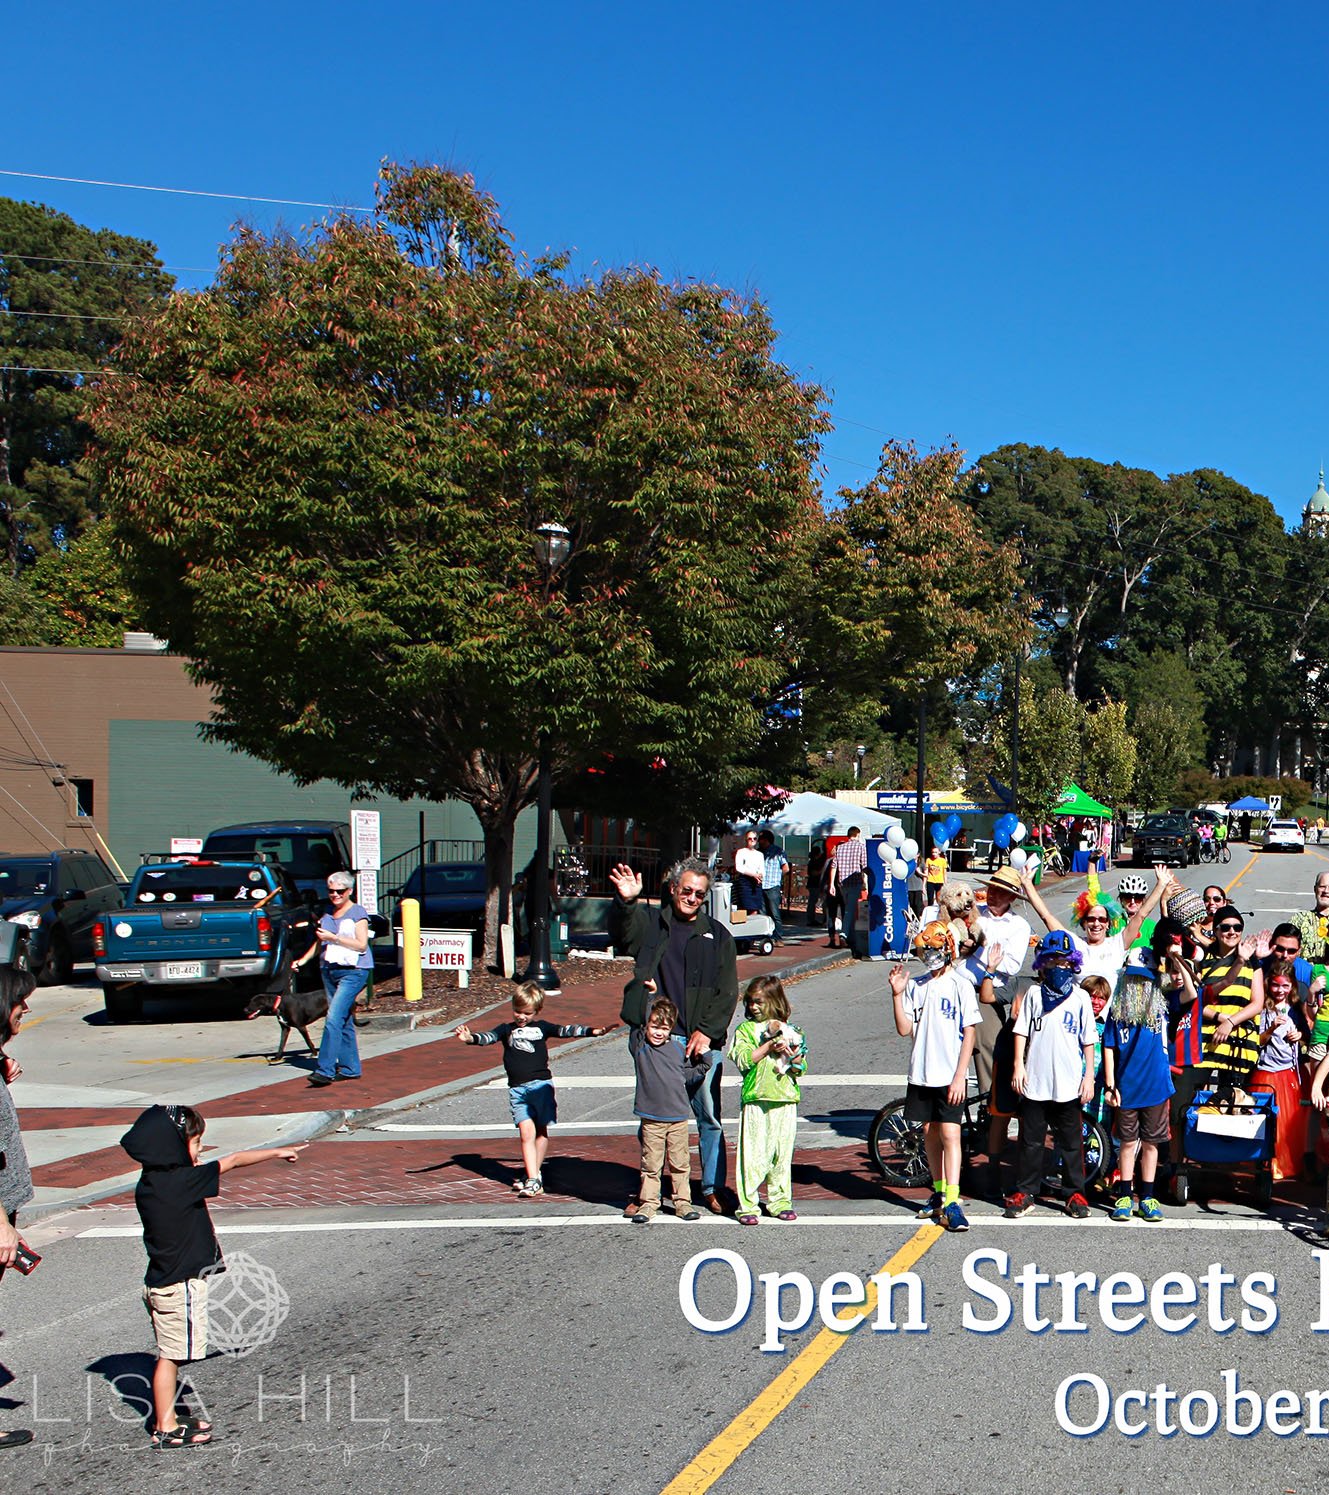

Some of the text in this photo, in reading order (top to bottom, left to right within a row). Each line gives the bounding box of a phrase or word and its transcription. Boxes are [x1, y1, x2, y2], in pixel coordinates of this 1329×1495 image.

[882, 861, 893, 889] Bank
[882, 892, 894, 943] Coldwell
[420, 937, 465, 947] S/pharmacy
[429, 952, 465, 966] ENTER
[1119, 1027, 1130, 1044] 13
